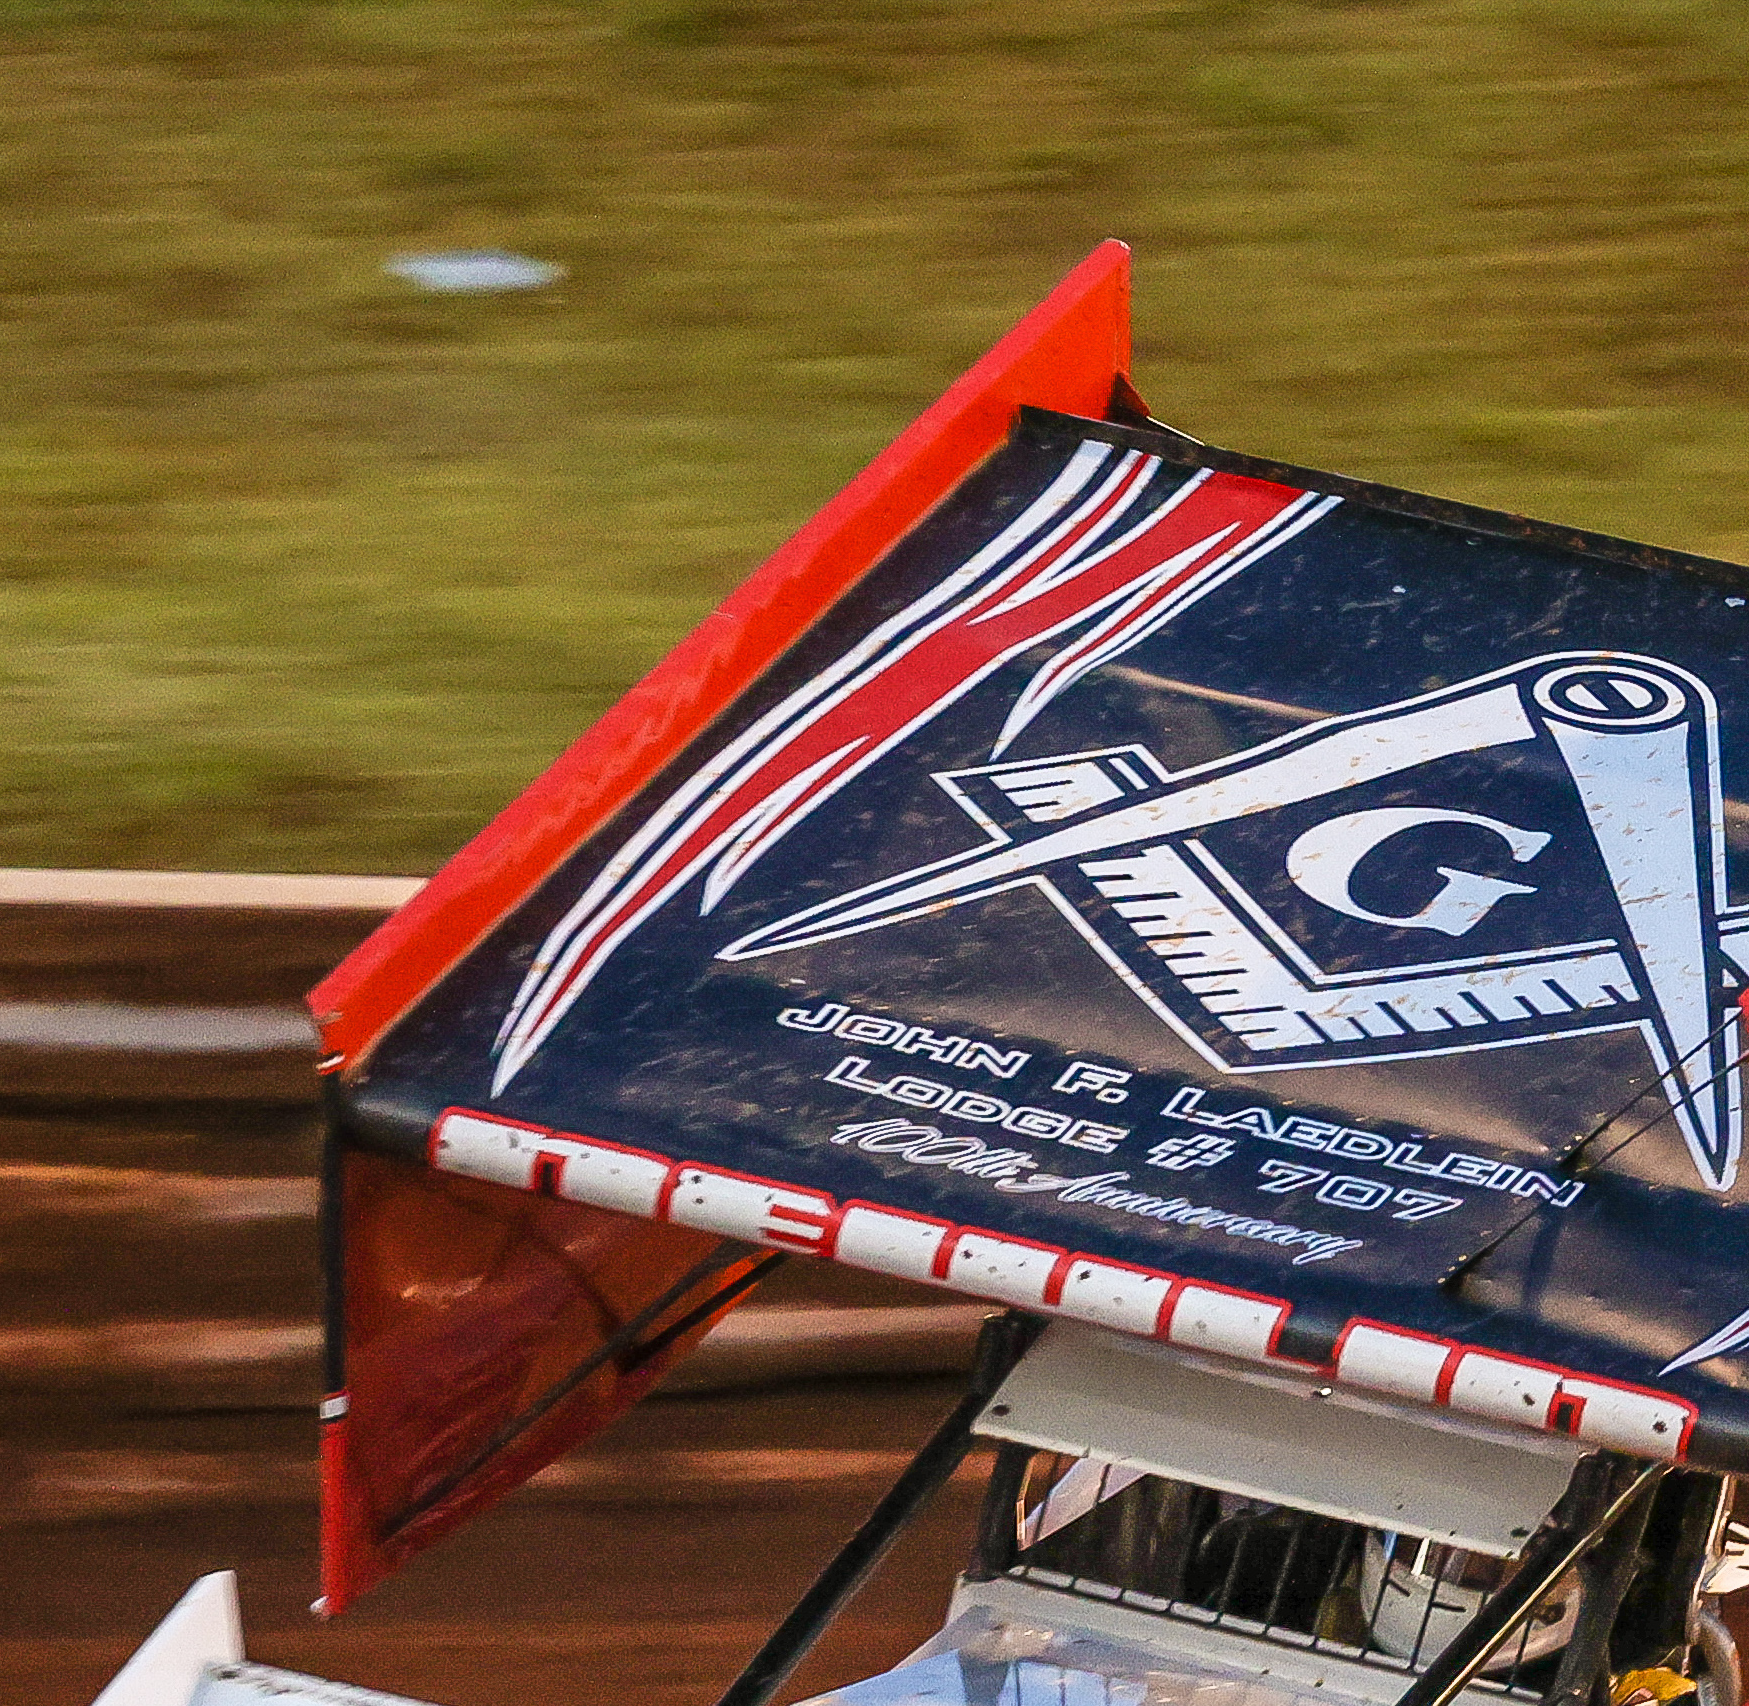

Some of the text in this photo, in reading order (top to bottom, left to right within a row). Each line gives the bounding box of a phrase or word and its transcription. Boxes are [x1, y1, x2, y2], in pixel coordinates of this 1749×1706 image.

[1286, 805, 1553, 937] G
[776, 1002, 1586, 1207] JOHN F. LAEDLEIN
[824, 1056, 1464, 1221] LODGE # 707
